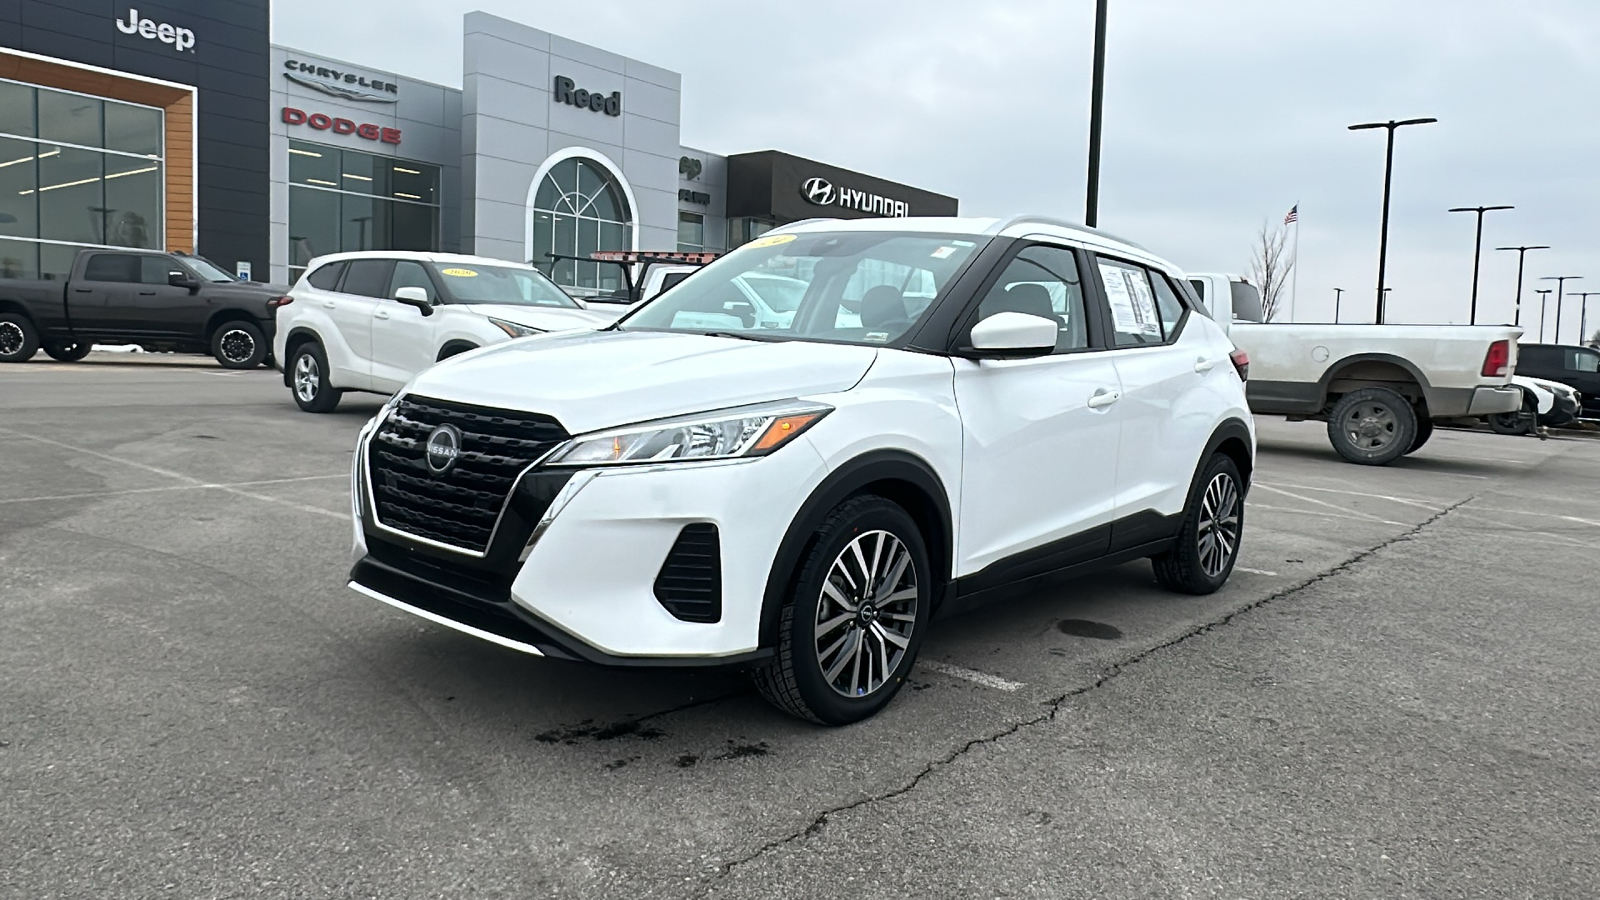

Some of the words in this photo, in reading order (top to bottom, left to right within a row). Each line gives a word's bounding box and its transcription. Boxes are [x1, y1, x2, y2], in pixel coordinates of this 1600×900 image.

[116, 9, 195, 51] Jeep
[284, 59, 398, 95] CHRYSLER
[555, 75, 620, 116] Reed
[282, 107, 402, 144] DODGE
[679, 156, 702, 180] ep
[679, 188, 711, 206] AM
[840, 188, 909, 217] HYUNDAI
[427, 442, 458, 458] NISSAN
